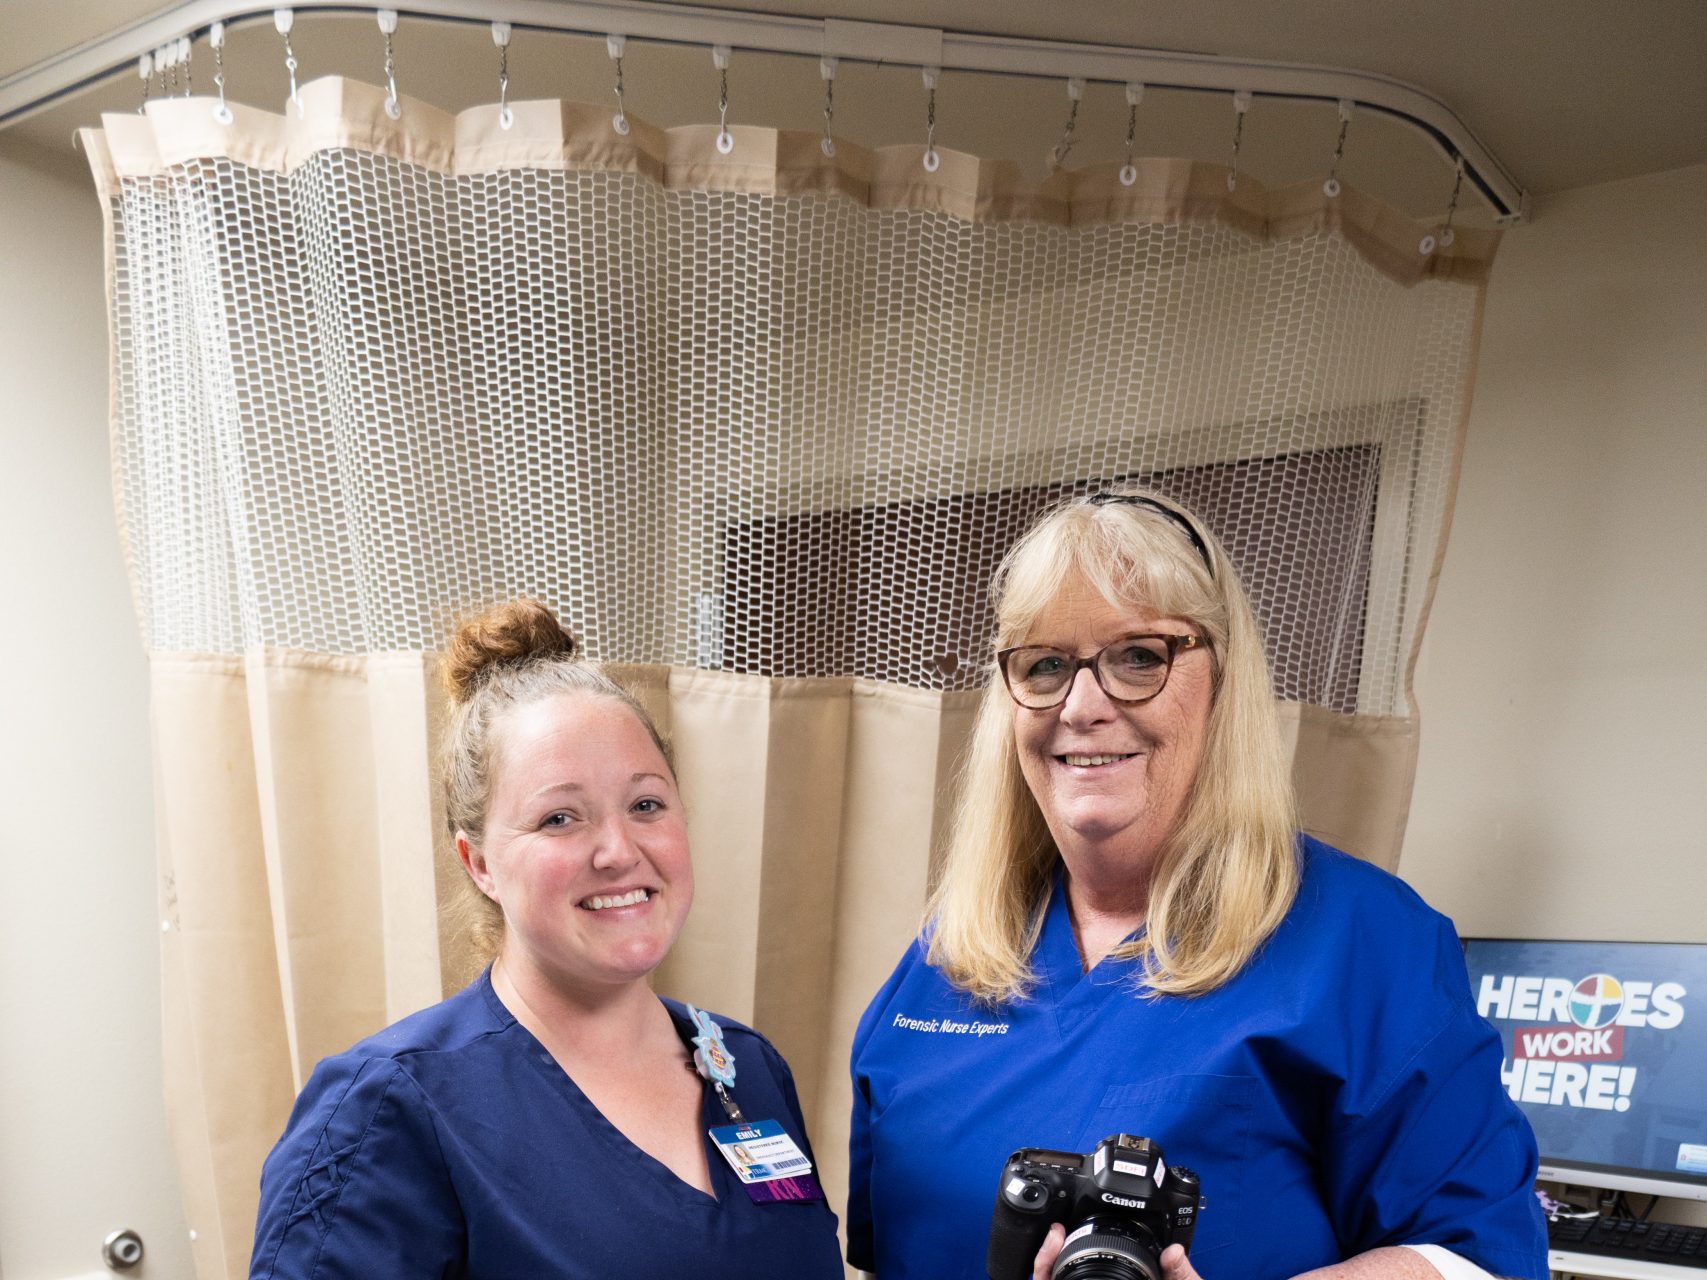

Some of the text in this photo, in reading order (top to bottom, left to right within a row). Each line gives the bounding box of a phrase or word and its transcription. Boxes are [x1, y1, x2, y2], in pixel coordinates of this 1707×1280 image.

[1477, 973, 1687, 1030] HEROES
[892, 1013, 1010, 1037] Forensic Nurse Experts
[1522, 1029, 1614, 1058] WORK
[1500, 1057, 1637, 1113] HERE!
[736, 1129, 762, 1140] EMILY
[765, 1178, 804, 1200] RN
[1101, 1192, 1146, 1209] Canon
[1178, 1207, 1193, 1215] EOS
